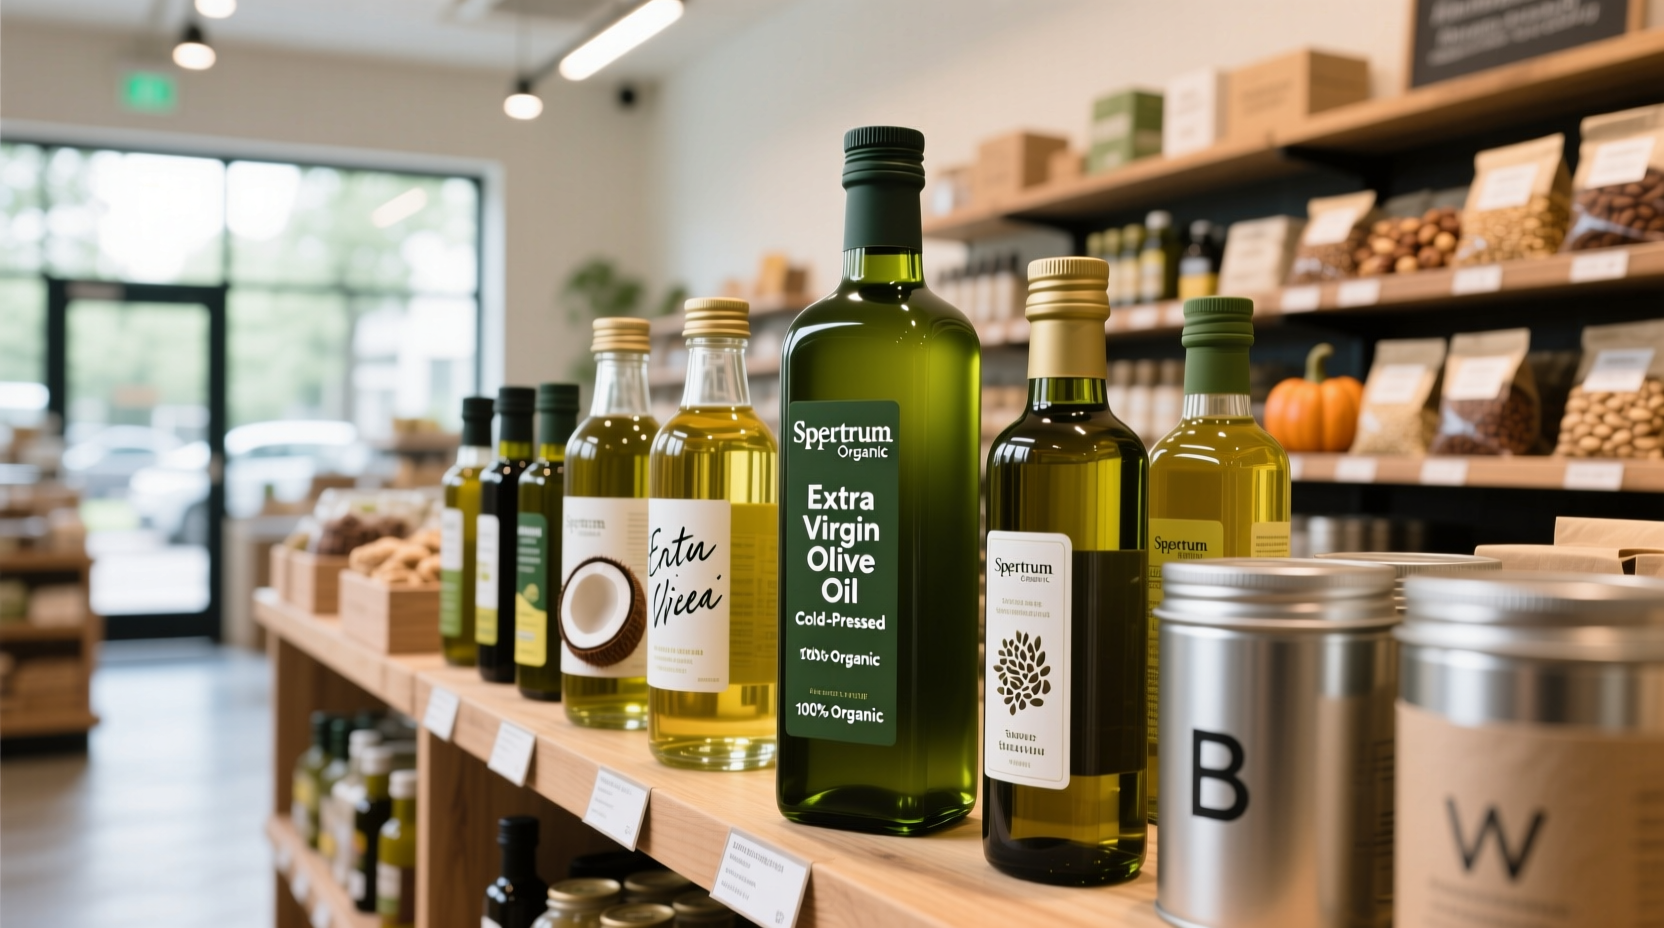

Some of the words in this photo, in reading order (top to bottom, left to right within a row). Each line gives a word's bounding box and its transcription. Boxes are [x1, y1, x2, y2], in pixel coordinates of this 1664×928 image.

[793, 420, 893, 450] Spertrum
[837, 444, 888, 462] Organic
[807, 484, 875, 511] Extra
[802, 514, 880, 549] Virgin
[807, 545, 876, 574] Olive
[821, 577, 858, 604] Oil
[795, 610, 886, 631] Cold-Pressed
[830, 649, 881, 669] Organic
[795, 702, 829, 719] 100%
[830, 704, 884, 725] Organic
[1192, 729, 1250, 822] B
[1446, 796, 1547, 884] W
